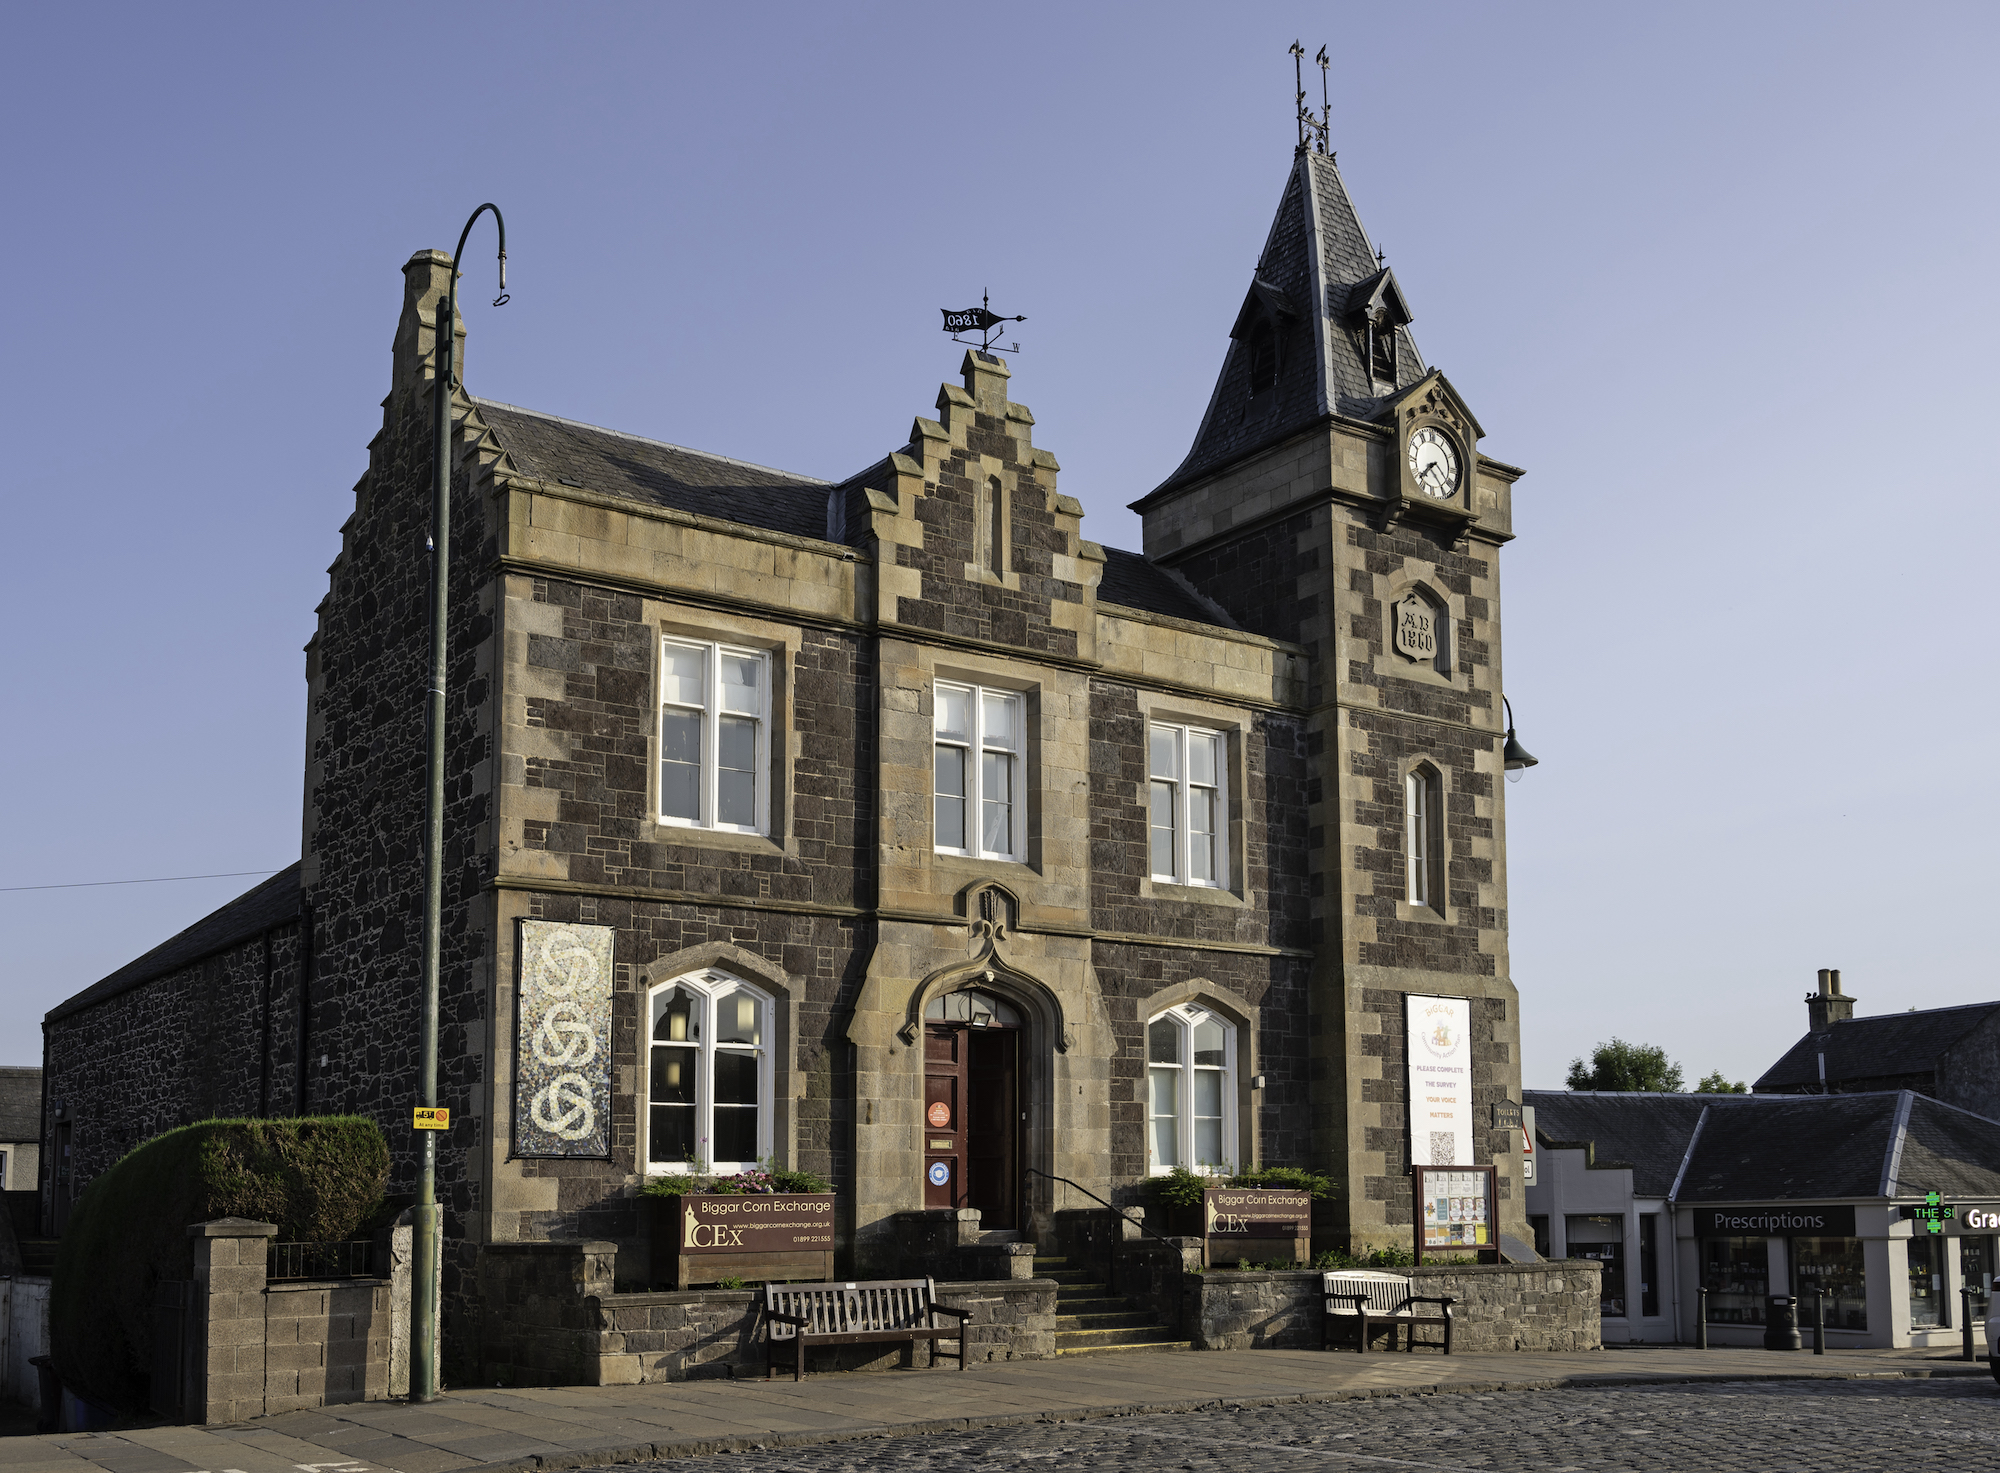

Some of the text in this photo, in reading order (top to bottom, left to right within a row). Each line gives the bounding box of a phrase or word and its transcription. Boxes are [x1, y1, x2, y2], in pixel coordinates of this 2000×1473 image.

[1401, 628, 1433, 652] 1860
[1425, 1004, 1454, 1018] BIGGAR
[1421, 1031, 1442, 1059] Community
[1442, 1047, 1457, 1059] Action
[1425, 1080, 1435, 1088] THE
[1441, 1096, 1457, 1104] VOICE
[1496, 1108, 1520, 1116] TOILETS
[1218, 1194, 1308, 1206] Biggar Corn Exchange
[701, 1200, 831, 1215] Biggar Corn Exchange
[1914, 1208, 1939, 1218] THE
[1714, 1212, 1825, 1232] Prescriptions
[1968, 1209, 2000, 1228] Gra
[732, 1221, 831, 1230] www.biggarcornexchange.org.uk
[793, 1235, 810, 1243] 01899
